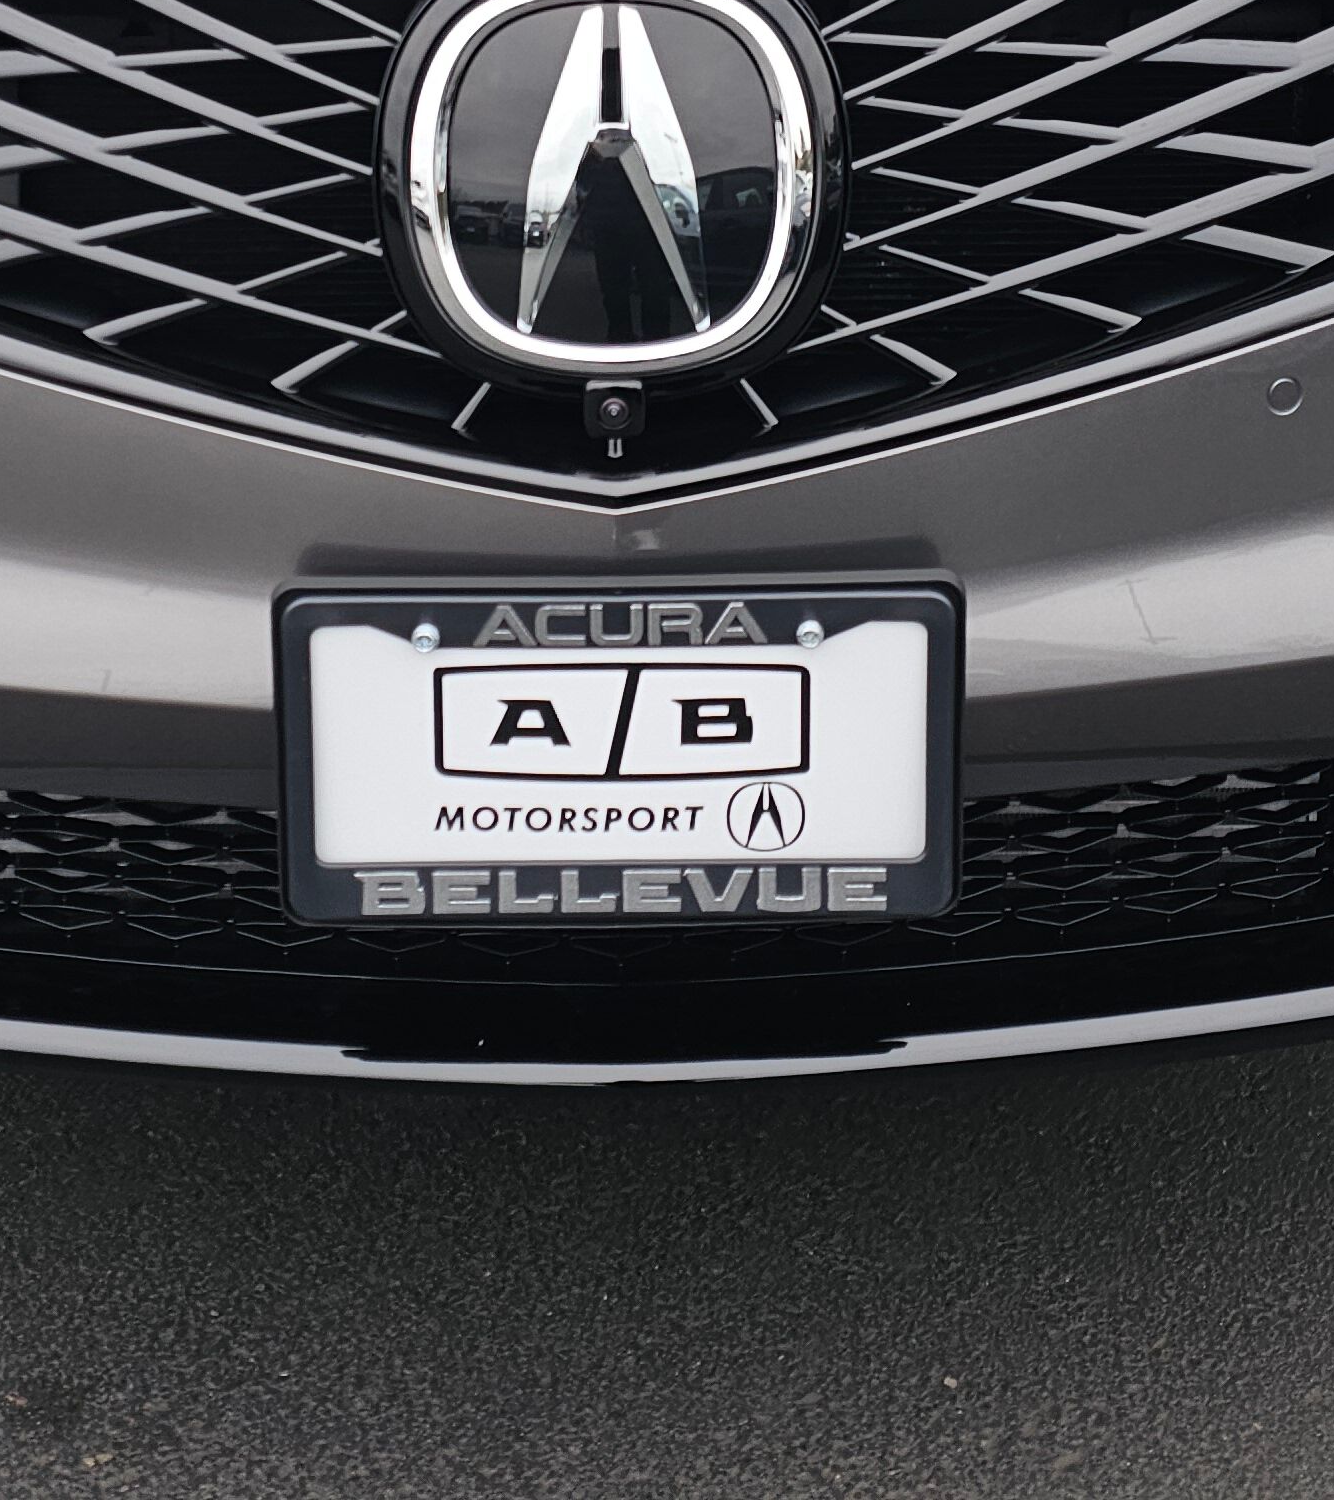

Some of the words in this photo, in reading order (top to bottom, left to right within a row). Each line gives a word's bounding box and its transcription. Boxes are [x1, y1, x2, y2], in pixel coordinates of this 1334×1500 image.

[473, 601, 768, 647] ACURA
[489, 699, 572, 747] A
[671, 697, 754, 747] B
[433, 805, 705, 833] MOTORSPORT
[354, 866, 887, 916] BELLEVUE
